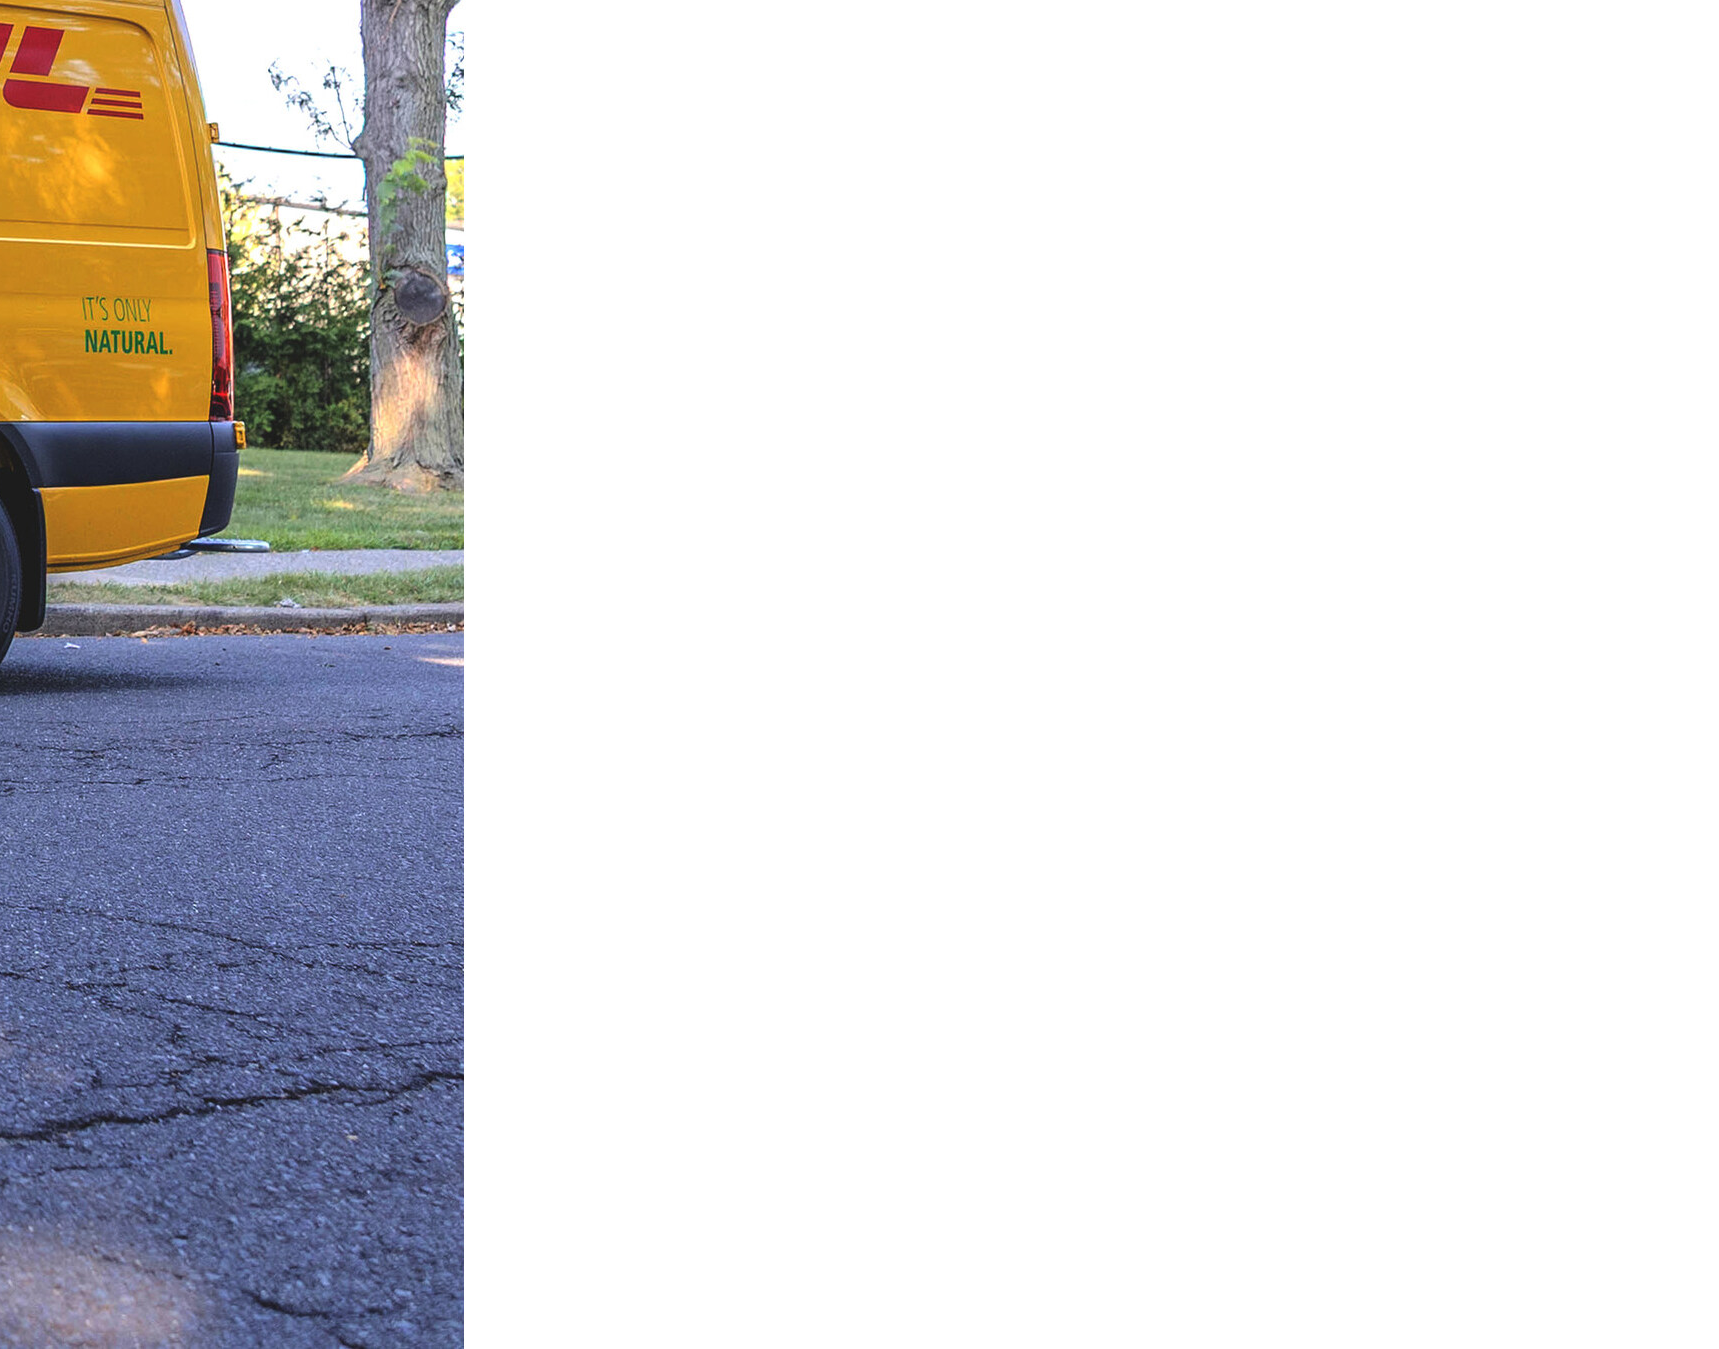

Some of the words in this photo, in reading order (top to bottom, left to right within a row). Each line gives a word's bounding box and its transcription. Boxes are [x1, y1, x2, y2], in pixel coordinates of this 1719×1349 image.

[82, 296, 108, 321] IT'S
[113, 298, 151, 322] ONLY
[85, 329, 173, 355] NATURAL.
